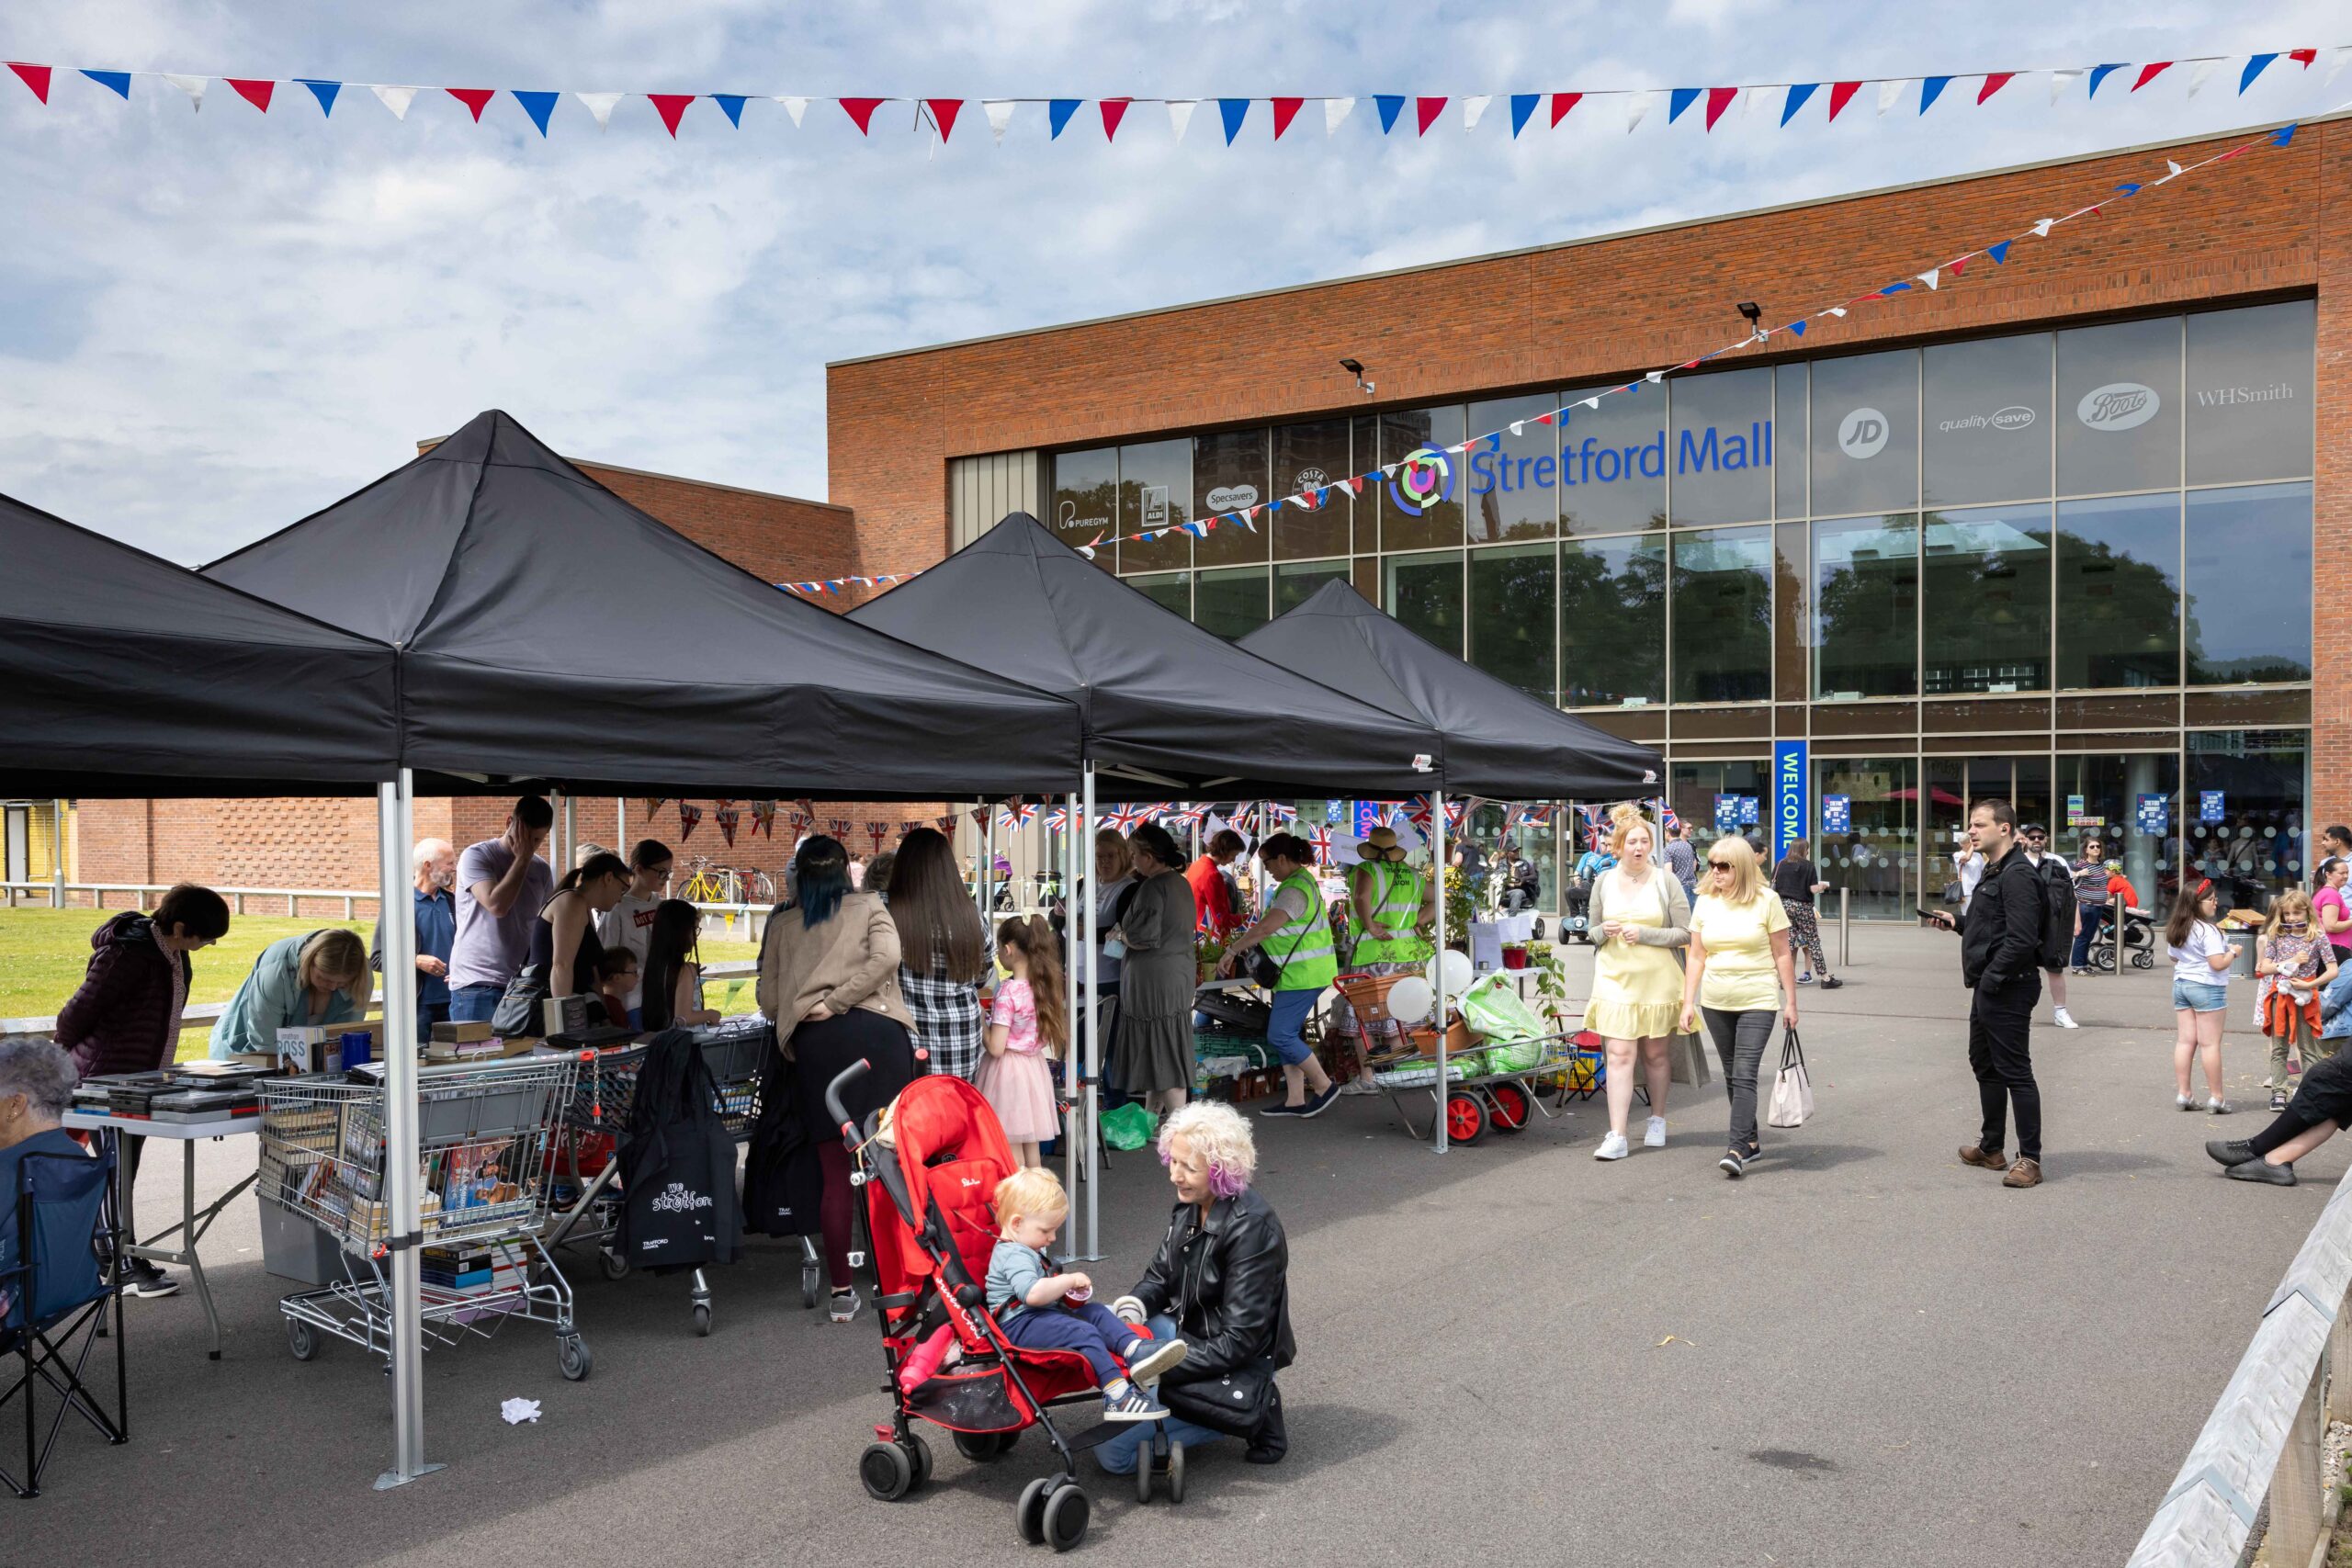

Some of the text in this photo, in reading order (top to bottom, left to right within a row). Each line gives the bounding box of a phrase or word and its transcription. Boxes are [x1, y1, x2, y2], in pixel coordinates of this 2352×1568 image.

[2197, 383, 2294, 407] WHSmith
[2086, 389, 2147, 423] Boots
[1939, 412, 2032, 433] quality save
[1846, 419, 1883, 446] JD
[1471, 421, 1773, 495] Stretford Mall
[1297, 469, 1324, 484] COSTA
[1211, 491, 1253, 504] Specsavers
[1075, 516, 1109, 527] PUREGYM
[1147, 512, 1163, 520] ALDI
[1783, 751, 1799, 849] WELCOME
[277, 1040, 305, 1056] ROSS
[668, 1182, 684, 1193] we
[642, 1238, 669, 1247] TRAFFORD
